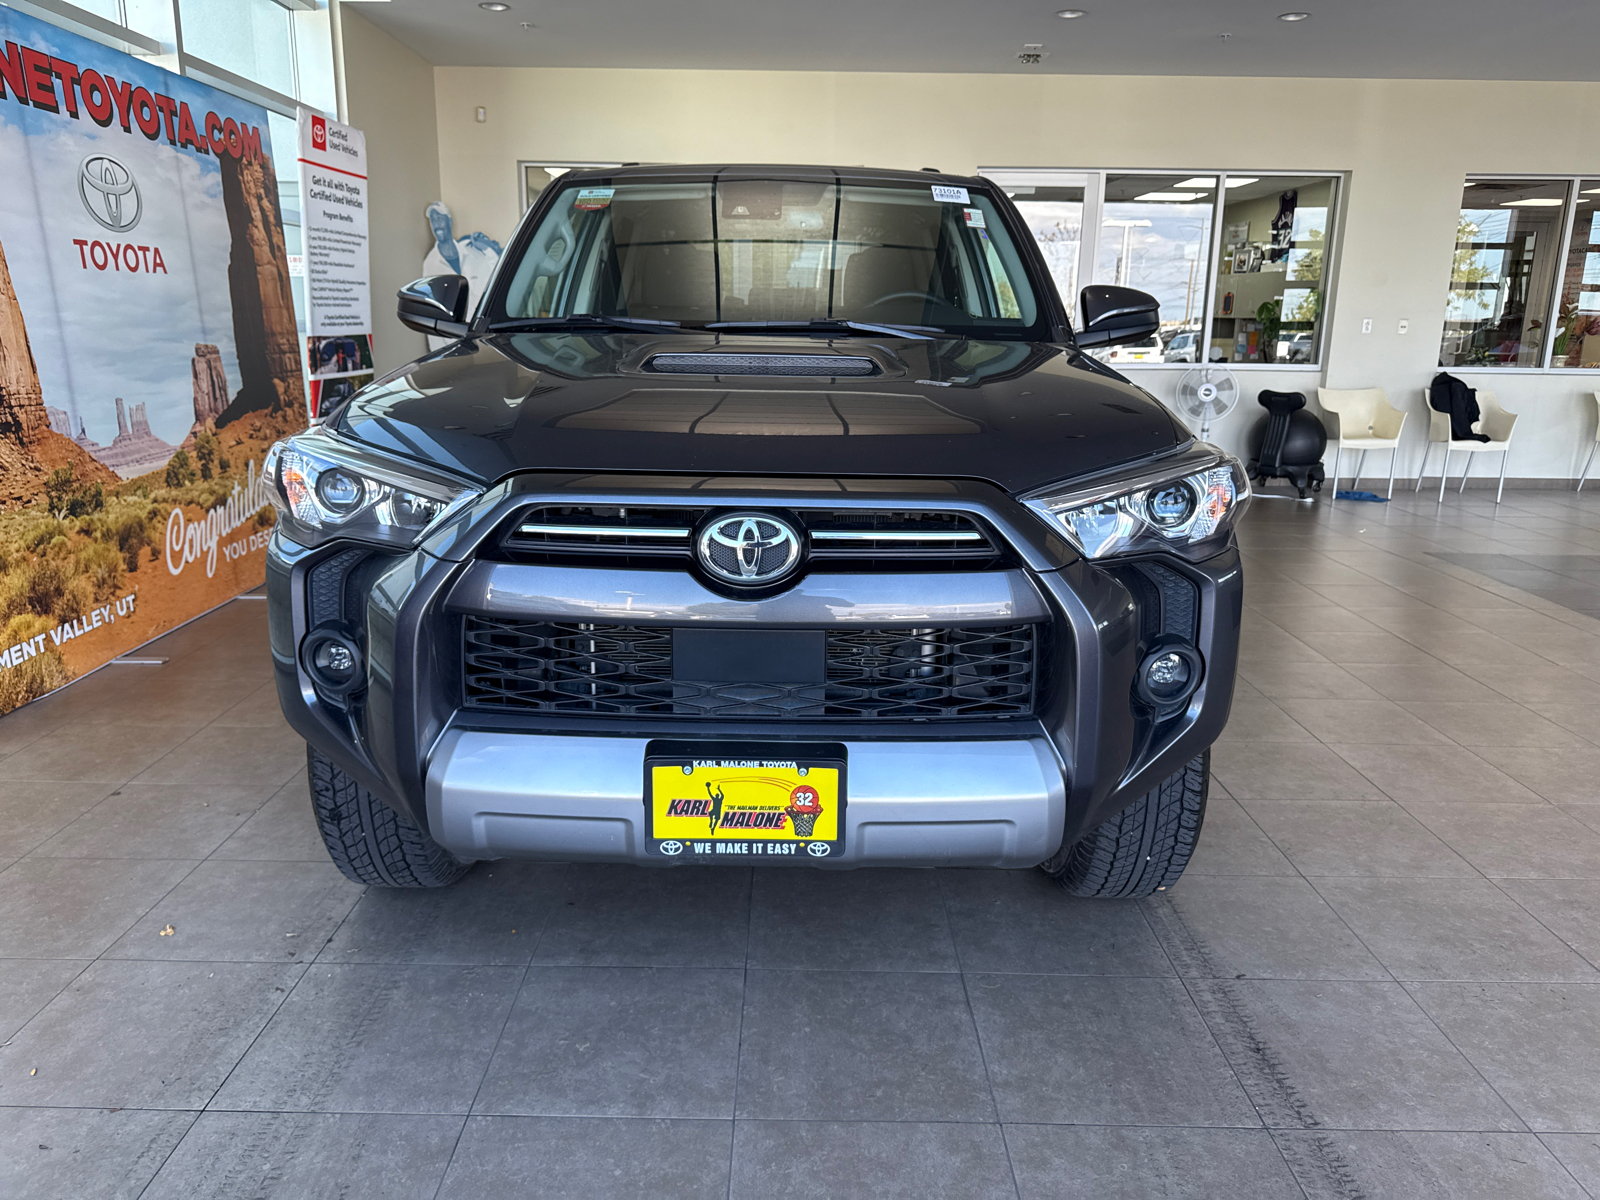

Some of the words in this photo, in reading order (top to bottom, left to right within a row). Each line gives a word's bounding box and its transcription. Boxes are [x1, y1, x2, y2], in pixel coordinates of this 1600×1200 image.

[0, 40, 263, 165] NETOYOTA.COM
[329, 127, 348, 142] Certified
[329, 140, 340, 151] Used
[342, 144, 358, 157] Vehicles
[312, 175, 322, 186] Get
[334, 181, 344, 192] with
[345, 184, 360, 196] Toyota
[310, 189, 332, 202] Certified
[332, 194, 344, 204] Used
[345, 197, 363, 208] Vehicles
[323, 210, 338, 221] Program
[339, 213, 354, 222] Benefits
[72, 238, 168, 274] TOYOTA
[222, 538, 247, 562] YOU
[50, 604, 114, 646] VALLEY,
[116, 594, 135, 616] UT
[666, 798, 712, 817] KARL
[796, 792, 813, 806] 32
[720, 811, 787, 829] MALONE
[694, 843, 711, 853] WE
[716, 843, 748, 854] MAKE
[752, 843, 764, 854] IT
[768, 843, 797, 854] EASY
